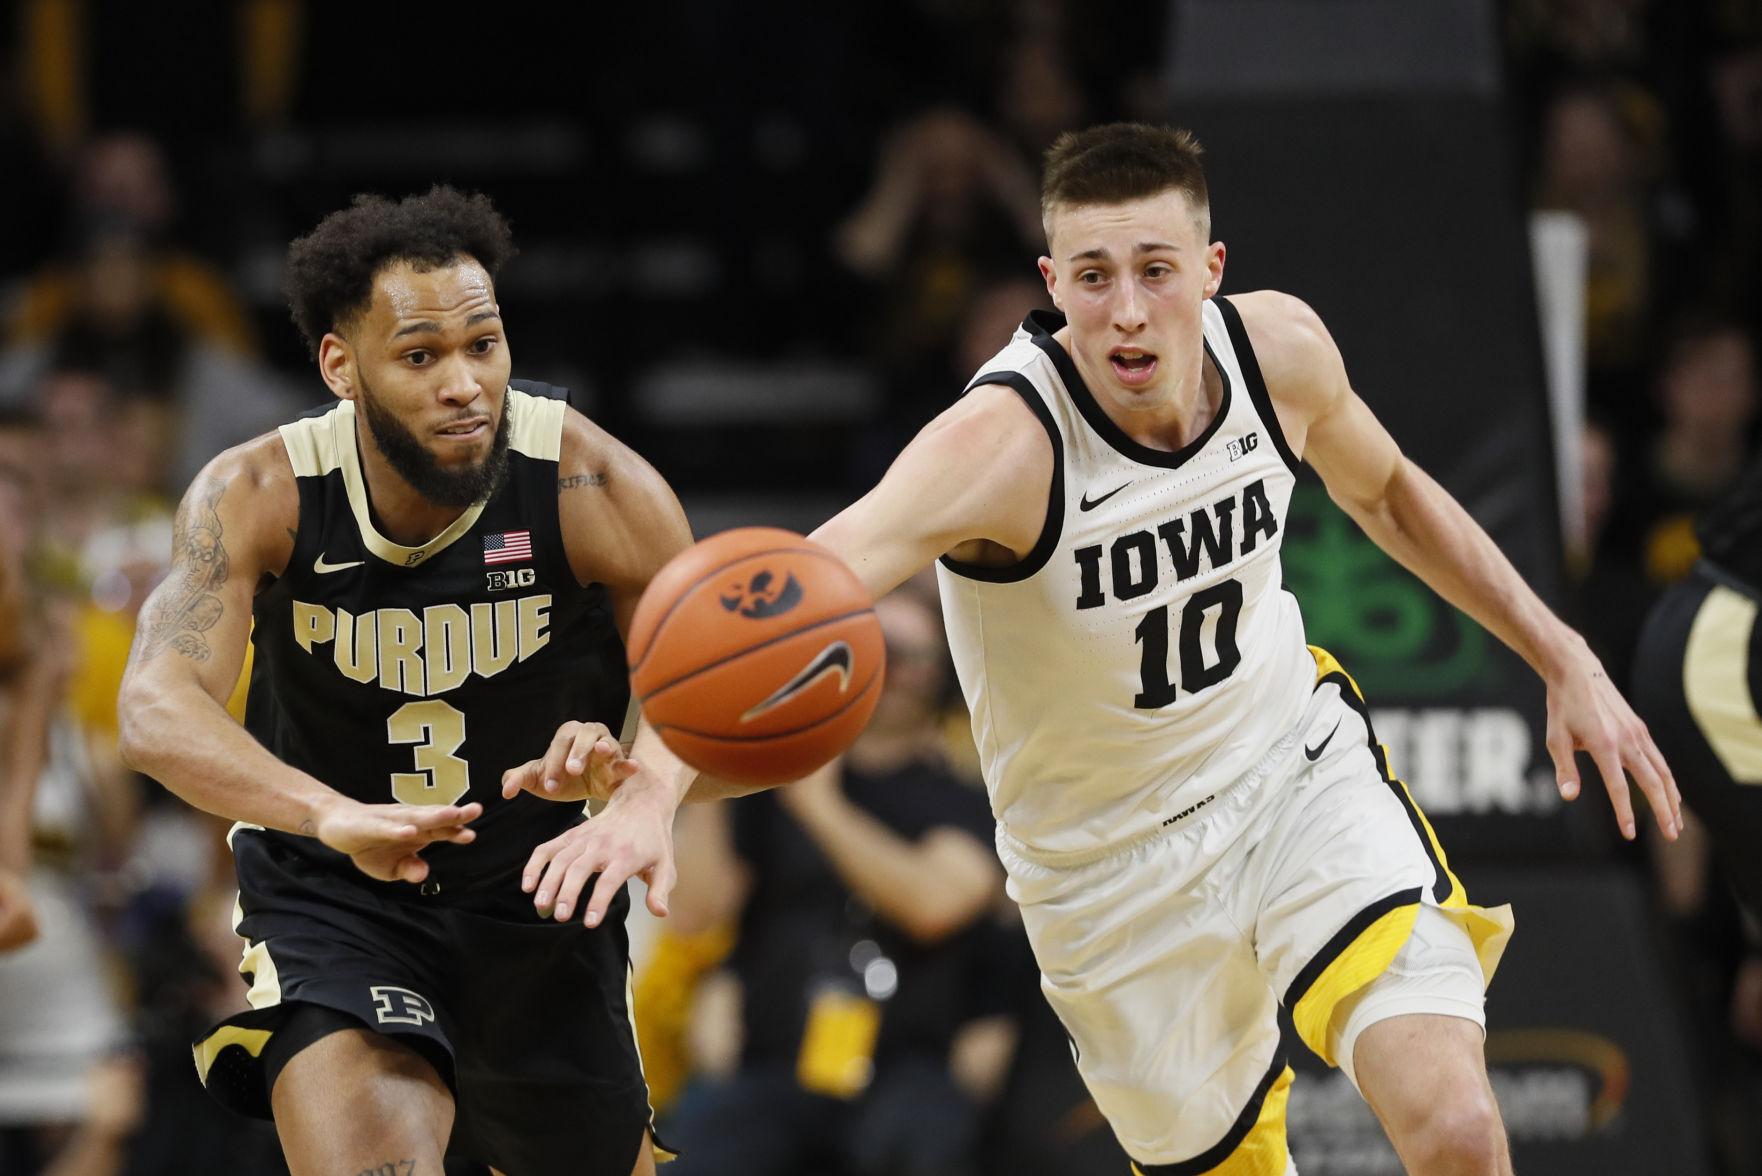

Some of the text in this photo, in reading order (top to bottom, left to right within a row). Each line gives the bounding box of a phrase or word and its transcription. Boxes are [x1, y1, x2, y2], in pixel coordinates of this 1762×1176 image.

[1074, 478, 1278, 610] IOWA
[292, 594, 552, 697] PURDUE
[1134, 578, 1244, 709] 10
[387, 699, 470, 807] 3
